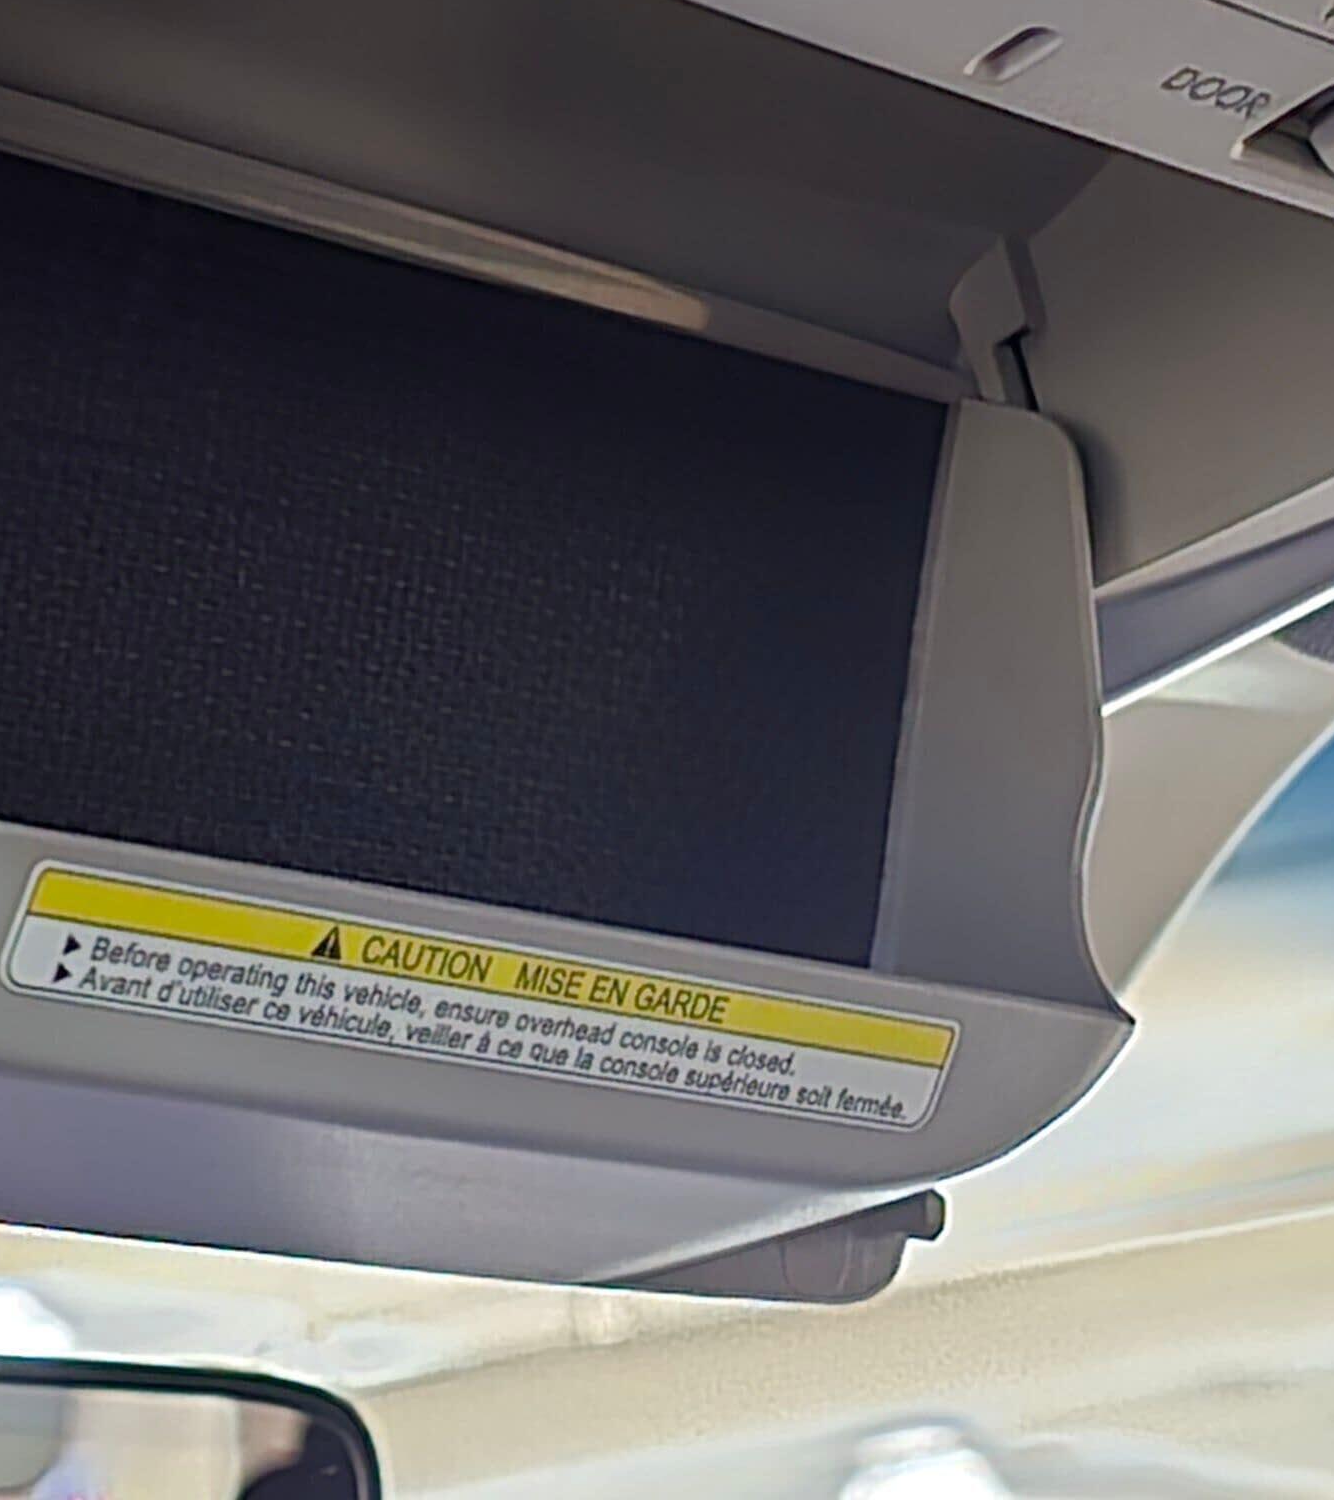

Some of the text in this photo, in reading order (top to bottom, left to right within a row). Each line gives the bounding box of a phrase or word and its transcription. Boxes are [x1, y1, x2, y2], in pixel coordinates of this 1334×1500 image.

[1160, 66, 1271, 119] DOOR
[90, 936, 796, 1077] Before operating this vehicle, ensure overhead console is closed.
[361, 935, 730, 1023] CAUTION MISE EN GARDE
[78, 966, 907, 1120] Avant d'utiliser ce véhicule, veiller à ce que la console supérieure soit fermée.
